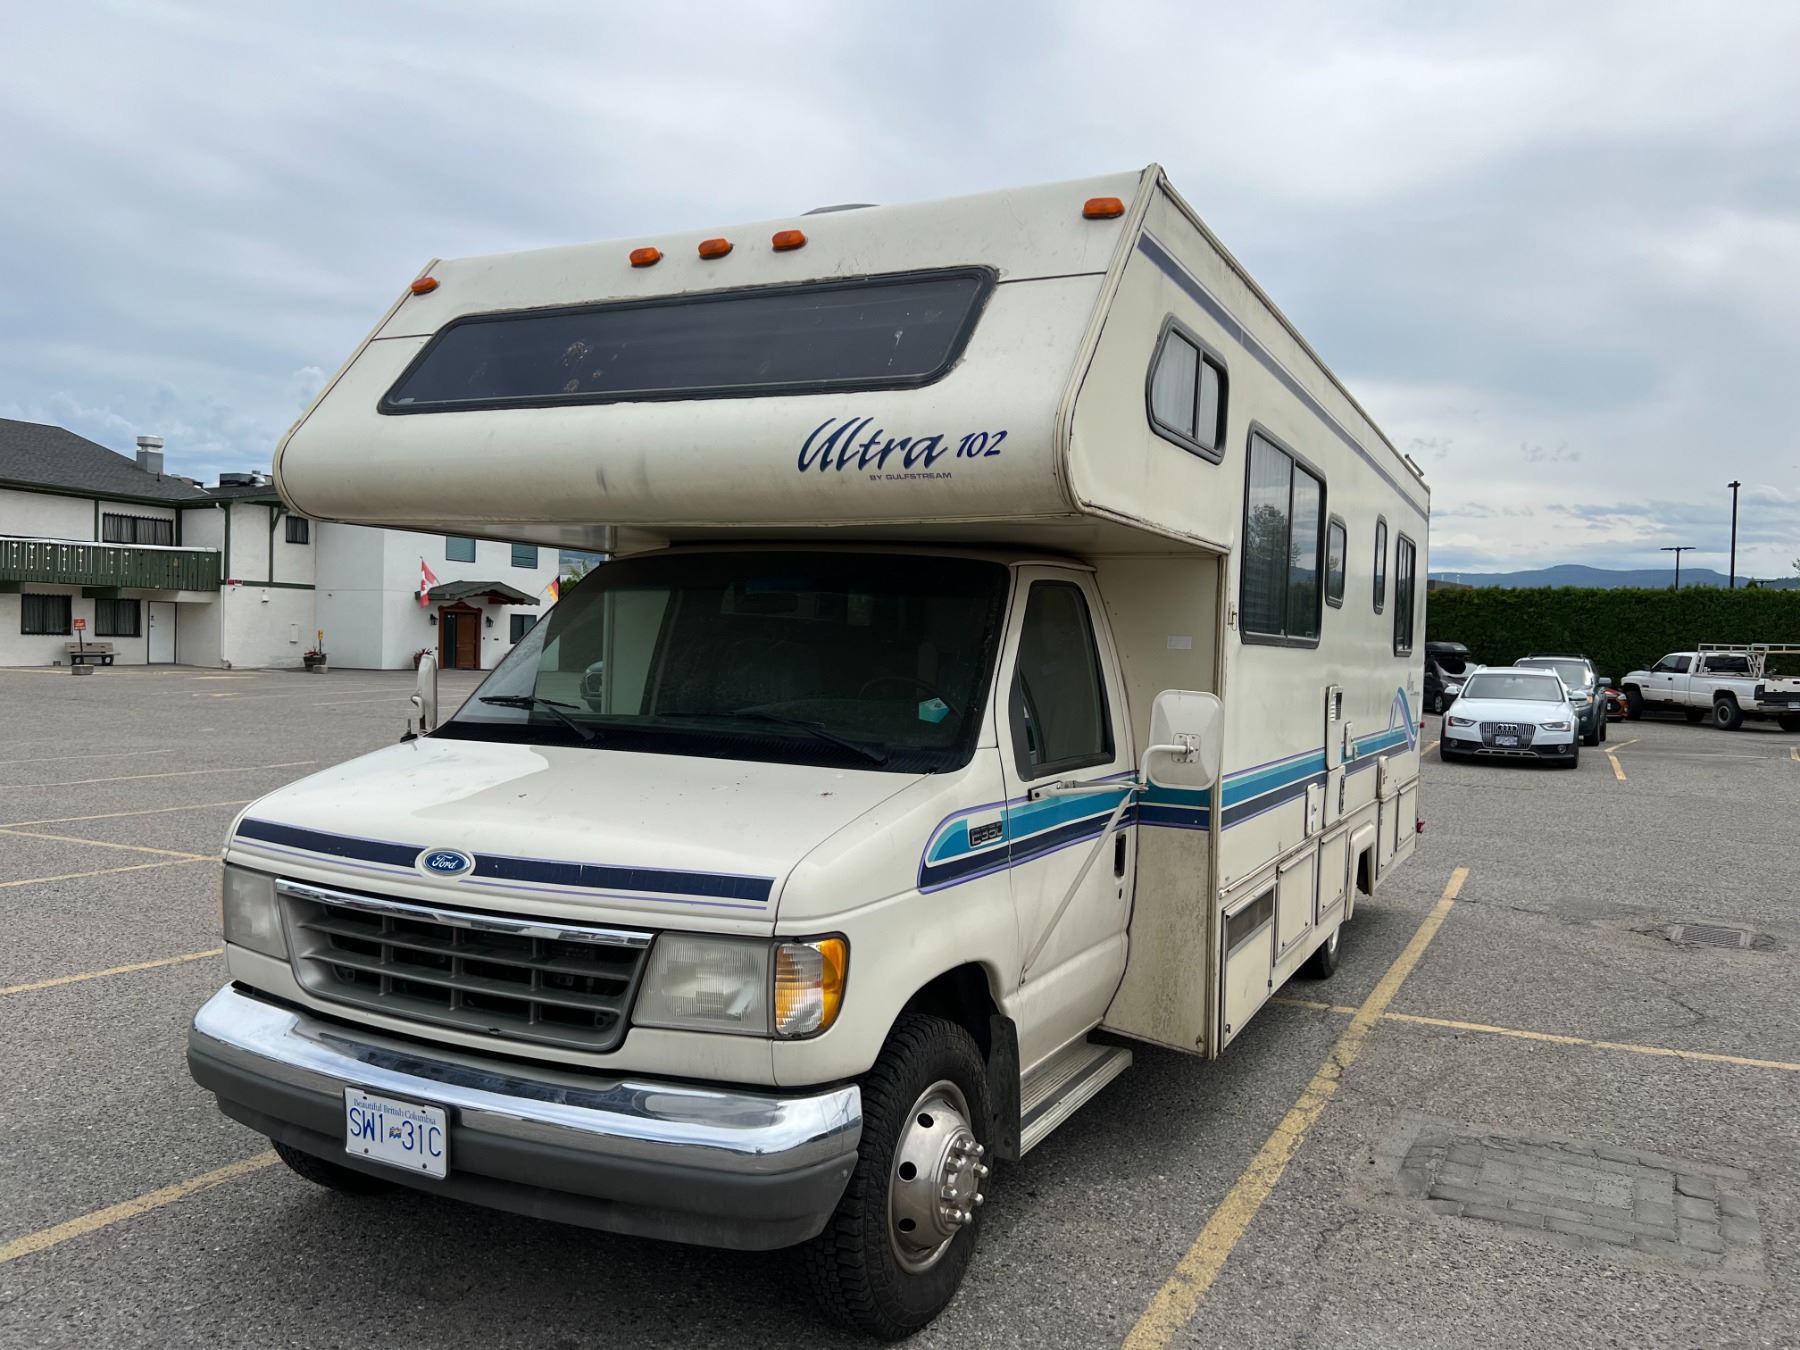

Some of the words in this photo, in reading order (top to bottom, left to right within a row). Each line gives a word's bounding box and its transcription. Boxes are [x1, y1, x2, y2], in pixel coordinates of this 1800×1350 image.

[798, 417, 948, 472] Ultra
[956, 430, 1008, 458] 102
[885, 472, 952, 481] GULFSTREAM
[431, 853, 459, 869] Ford
[353, 1098, 382, 1111] Beautiful
[383, 1105, 404, 1117] British
[404, 1110, 436, 1125] Columbia
